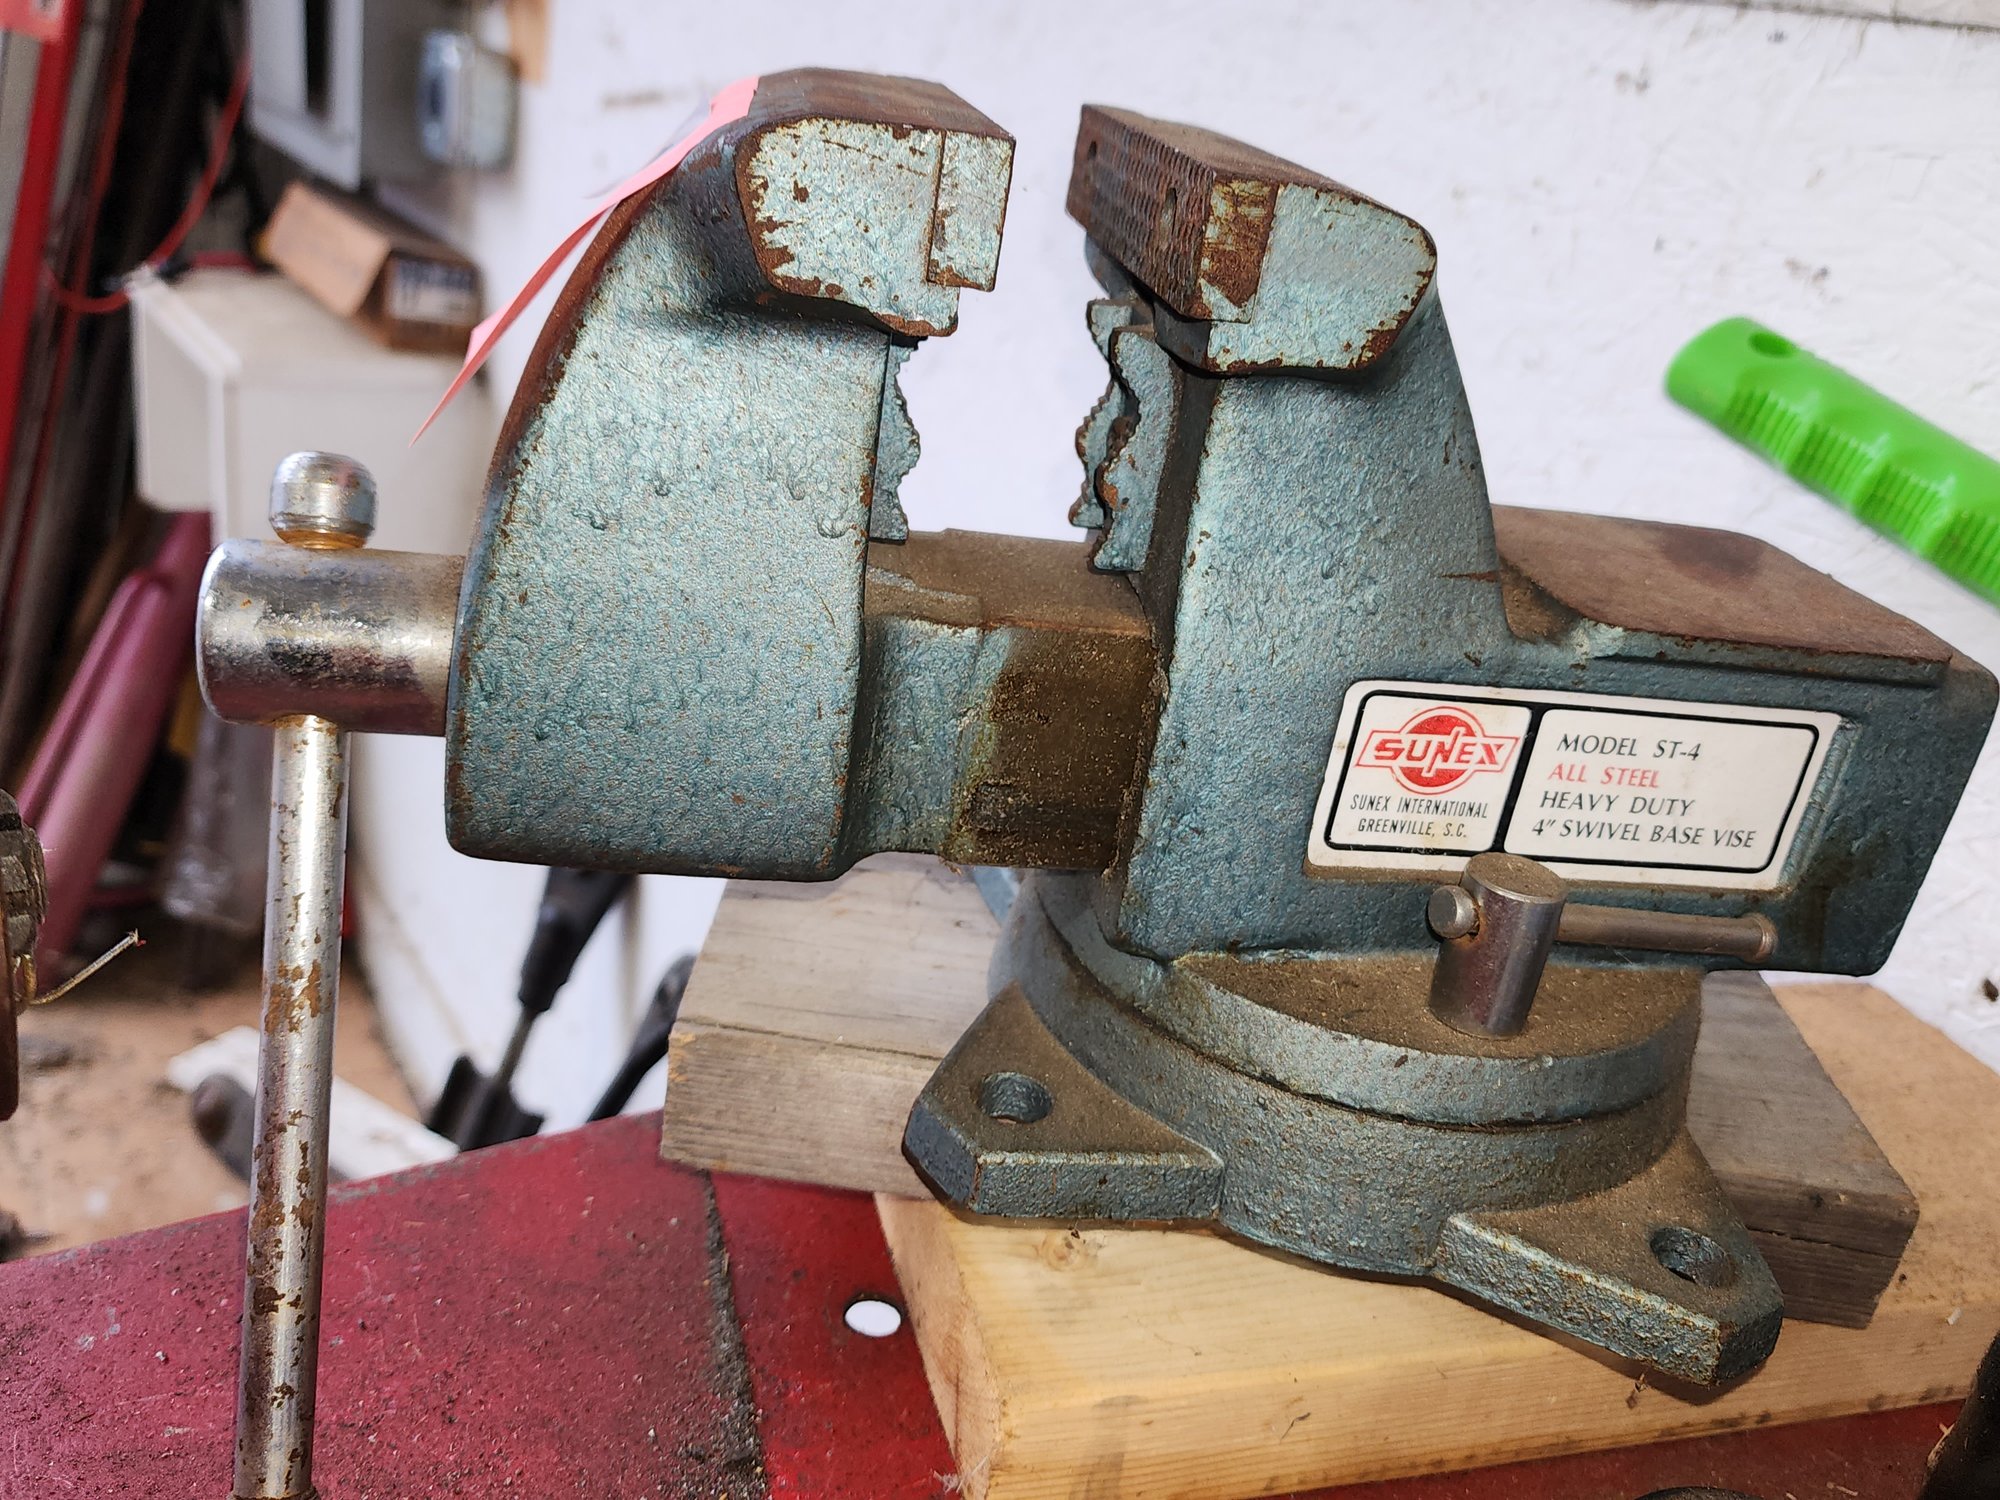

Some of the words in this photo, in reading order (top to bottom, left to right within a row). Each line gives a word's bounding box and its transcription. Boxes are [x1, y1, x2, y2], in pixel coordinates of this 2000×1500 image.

[1374, 728, 1504, 776] SUNEX
[1556, 733, 1637, 757] MODEL
[1653, 739, 1702, 761] ST-4
[1548, 762, 1587, 783] ALL
[1600, 766, 1661, 789] STEEL
[1350, 794, 1390, 812] SUNEX
[1397, 797, 1489, 819] INTERNATIONAL
[1539, 790, 1619, 812] HEAVY
[1629, 796, 1696, 817] DUTY
[1357, 818, 1435, 838] GREENVILLE,
[1443, 823, 1468, 838] S.C.
[1560, 819, 1641, 842] SWIVEL
[1650, 825, 1705, 845] BASE
[1713, 829, 1757, 848] VISE
